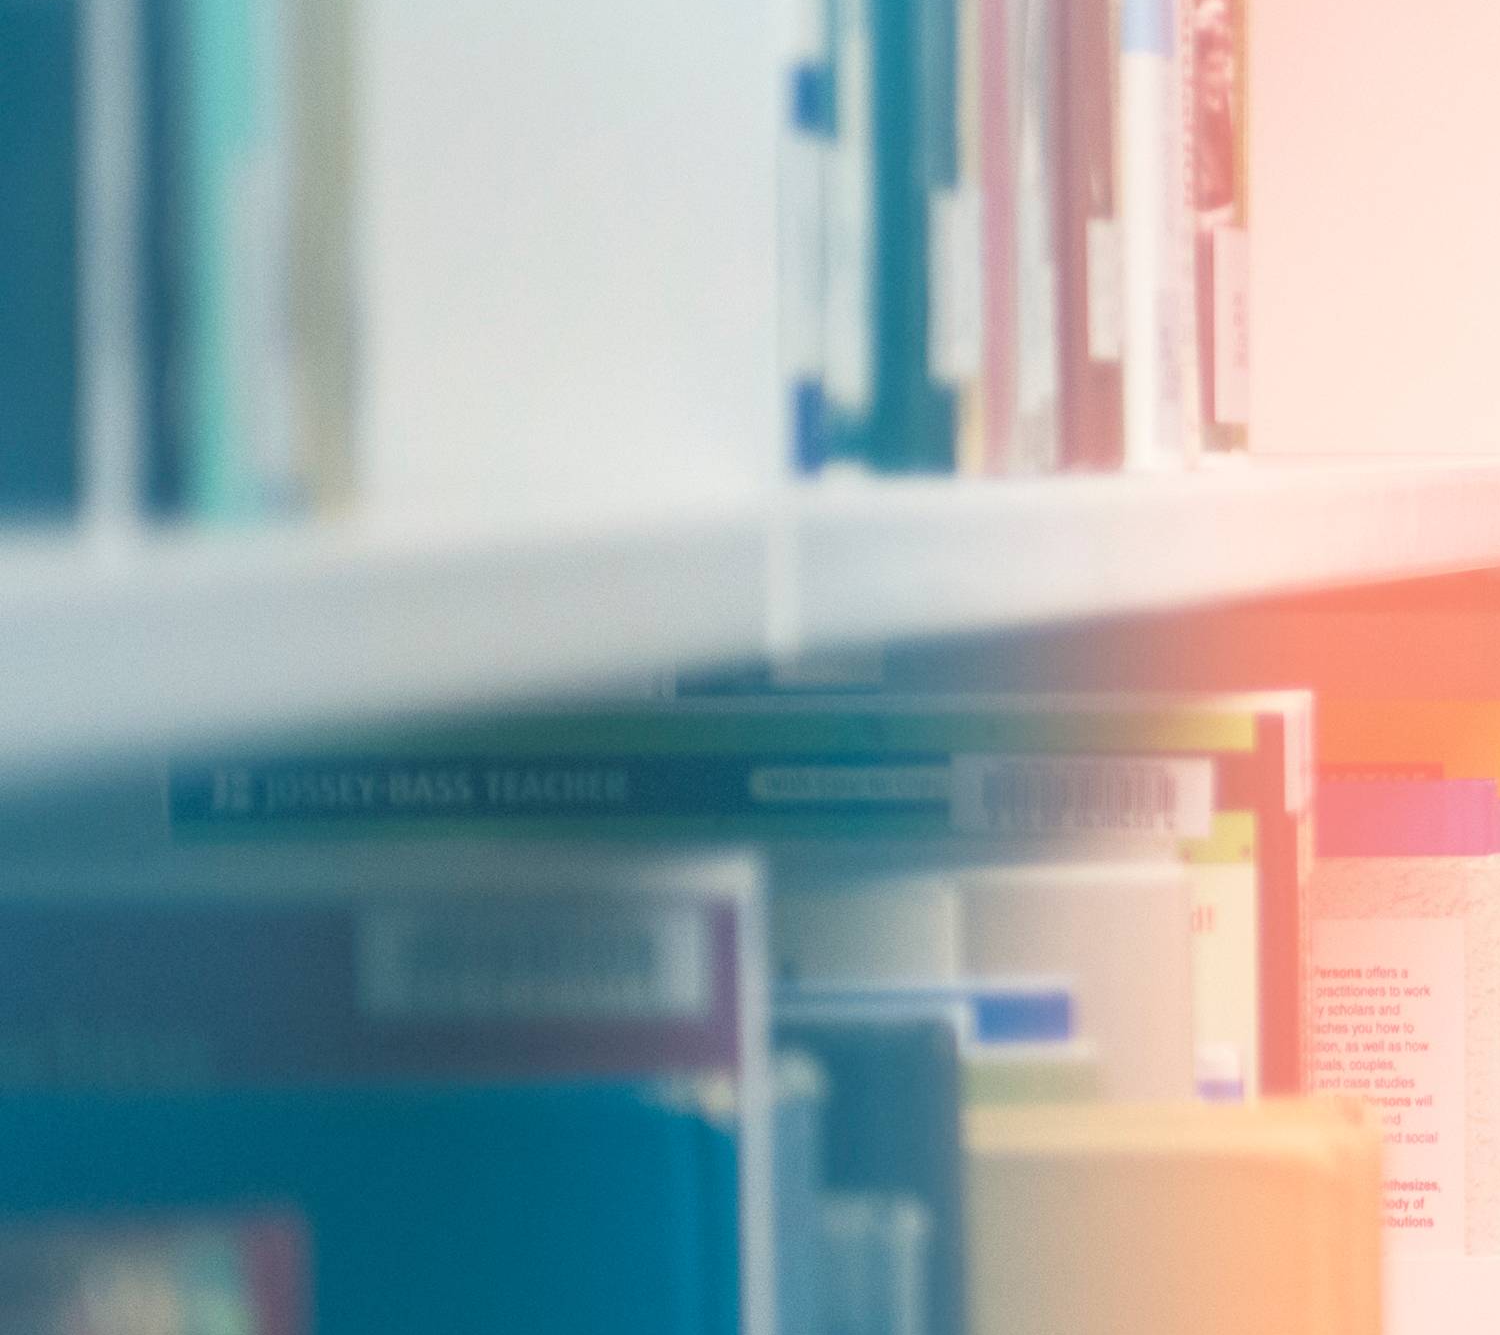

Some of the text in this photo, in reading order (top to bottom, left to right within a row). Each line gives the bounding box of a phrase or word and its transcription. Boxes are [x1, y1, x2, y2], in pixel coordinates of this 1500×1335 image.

[1365, 965, 1398, 979] offers
[1400, 969, 1409, 979] a
[1389, 986, 1400, 998] to
[1403, 984, 1431, 997] work
[1327, 1003, 1376, 1016] scholars
[1378, 1004, 1401, 1016] and
[1351, 1025, 1373, 1037] you
[1375, 1022, 1400, 1034] how
[1403, 1023, 1415, 1034] to
[1345, 1043, 1359, 1053] as
[1362, 1040, 1385, 1053] well
[1388, 1043, 1402, 1053] as
[1405, 1040, 1430, 1053] how
[1349, 1059, 1398, 1073] couples,
[1319, 1077, 1416, 1089] and case studies
[1415, 1094, 1434, 1107] will
[1405, 1130, 1439, 1144] social
[1382, 1178, 1442, 1193] thesizes,
[1383, 1196, 1425, 1211] ody of
[1387, 1216, 1435, 1229] butions
